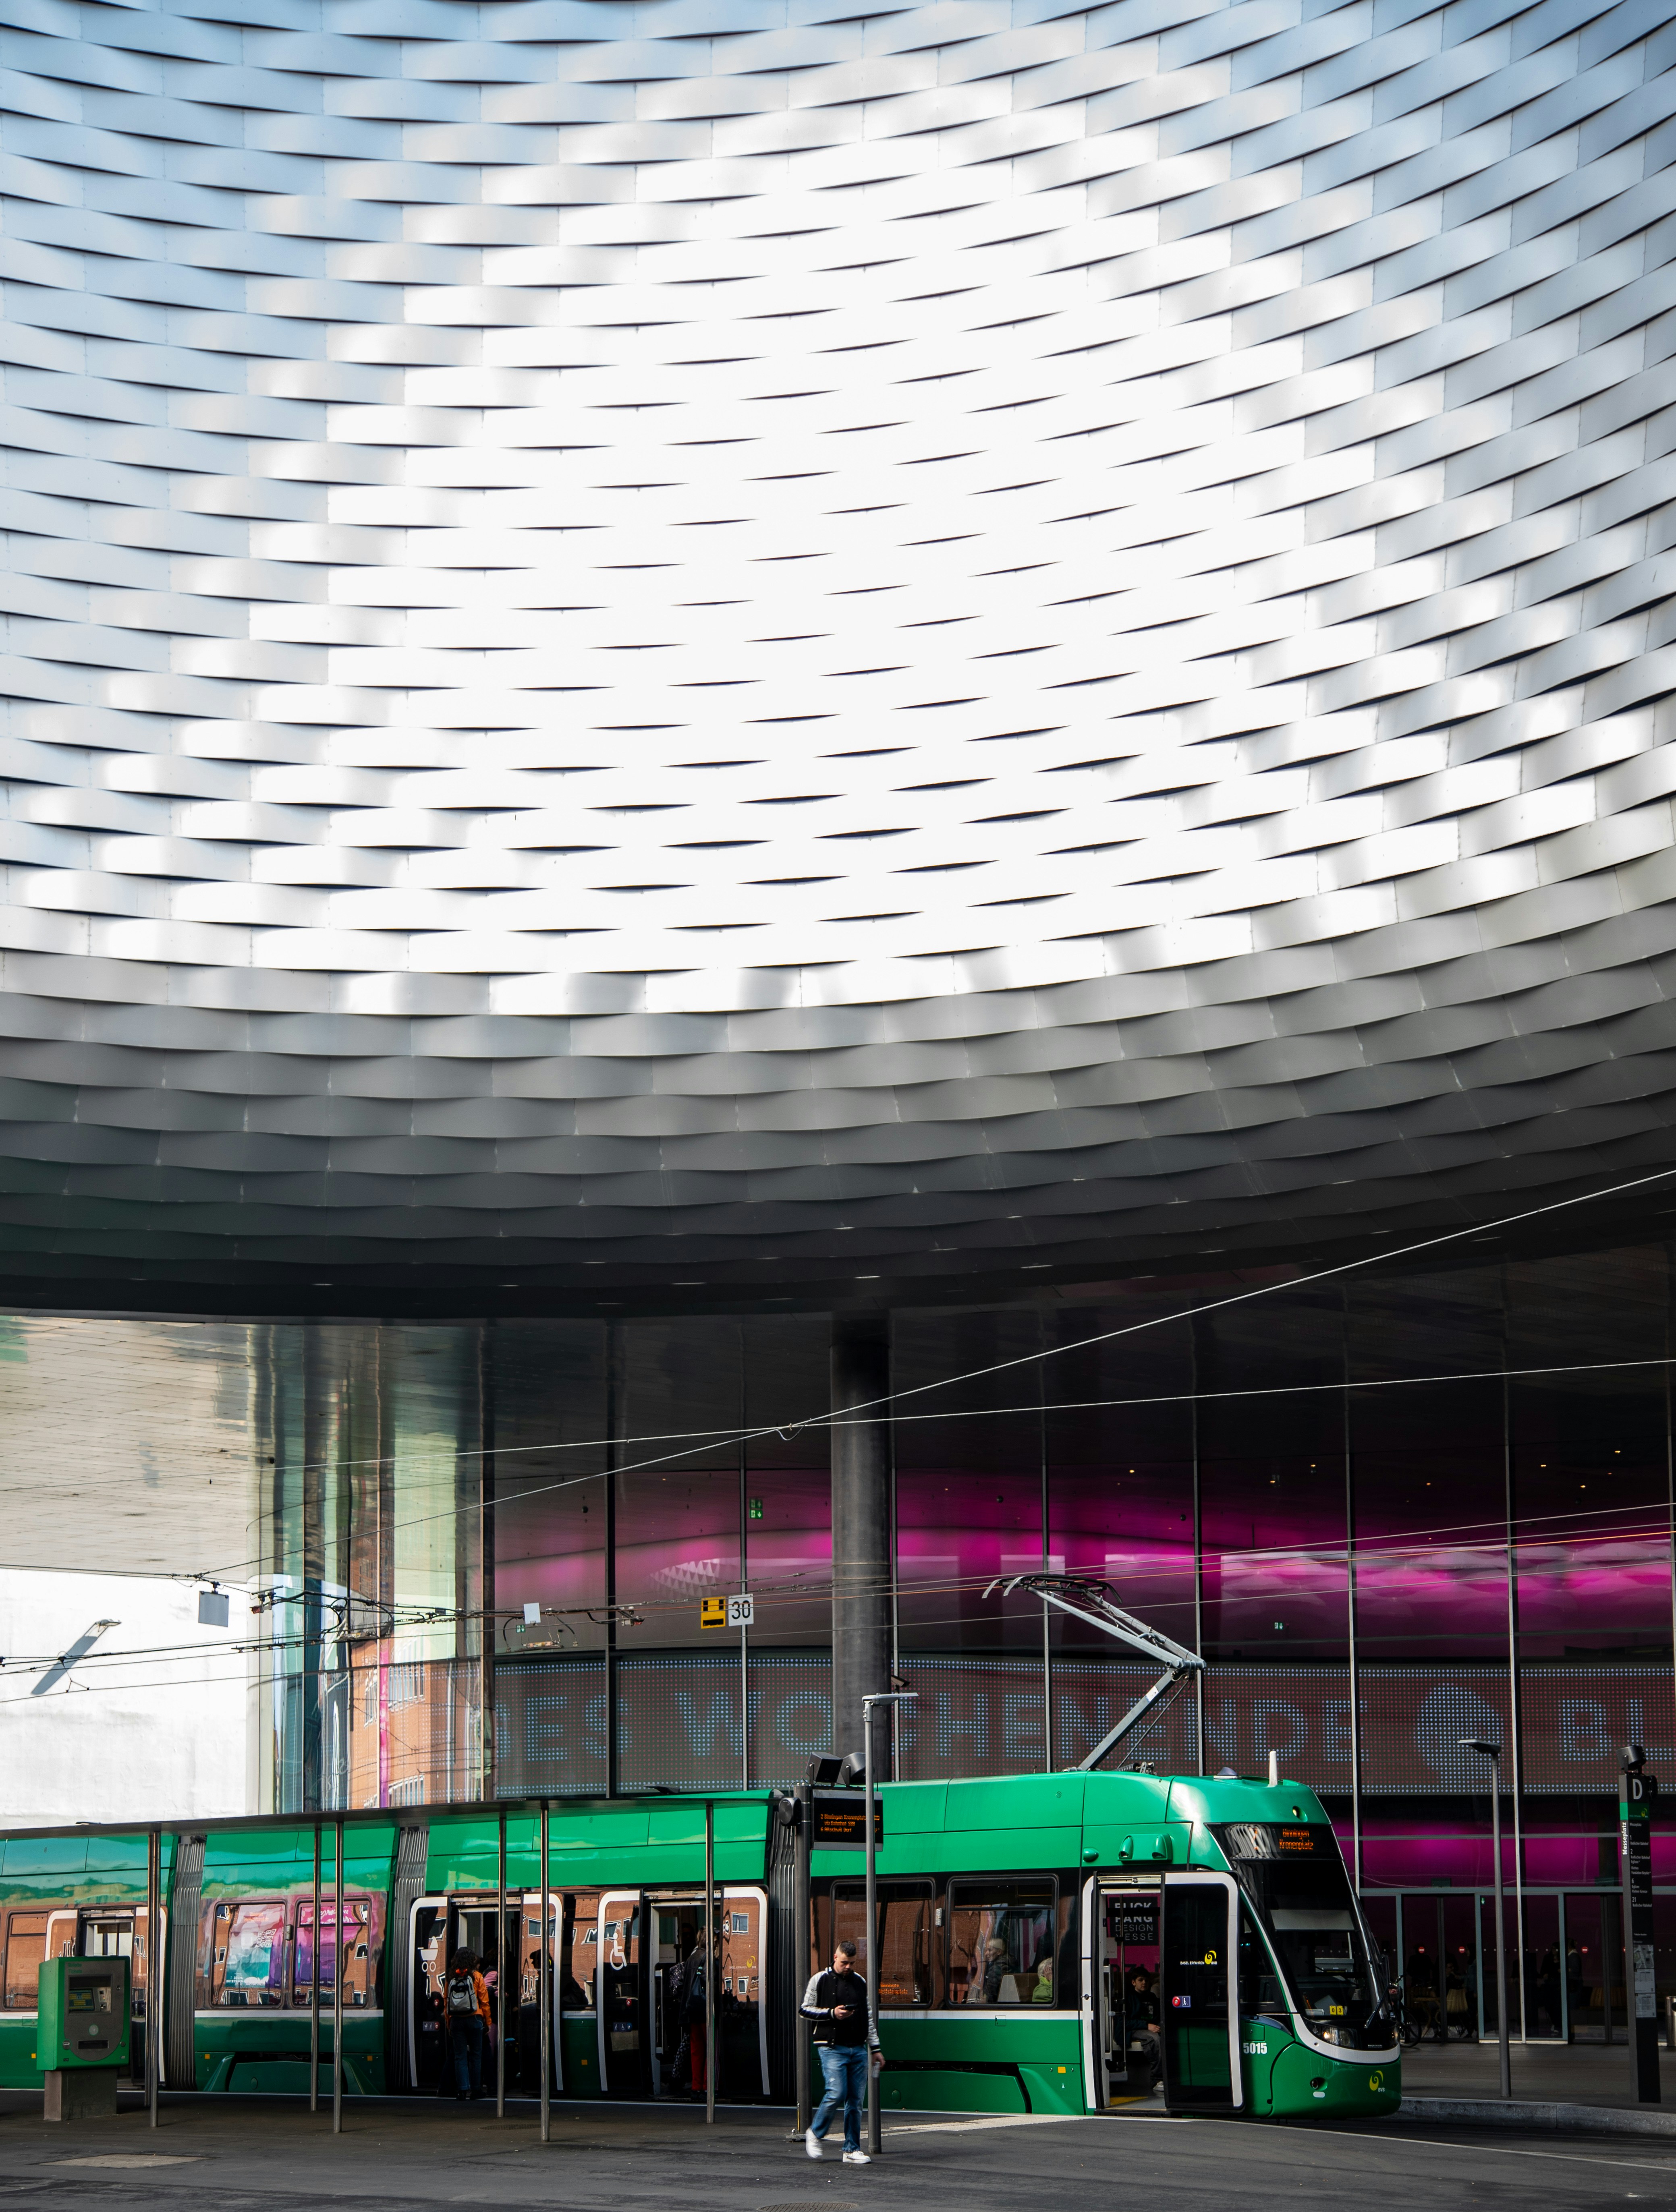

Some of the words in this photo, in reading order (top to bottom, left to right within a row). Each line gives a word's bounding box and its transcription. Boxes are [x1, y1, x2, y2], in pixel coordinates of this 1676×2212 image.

[732, 1600, 751, 1620] 30
[1632, 1779, 1643, 1800] D
[1282, 1829, 1309, 1839] Binningen
[1279, 1839, 1313, 1851] Kronenplatz
[1243, 2042, 1268, 2055] 5015
